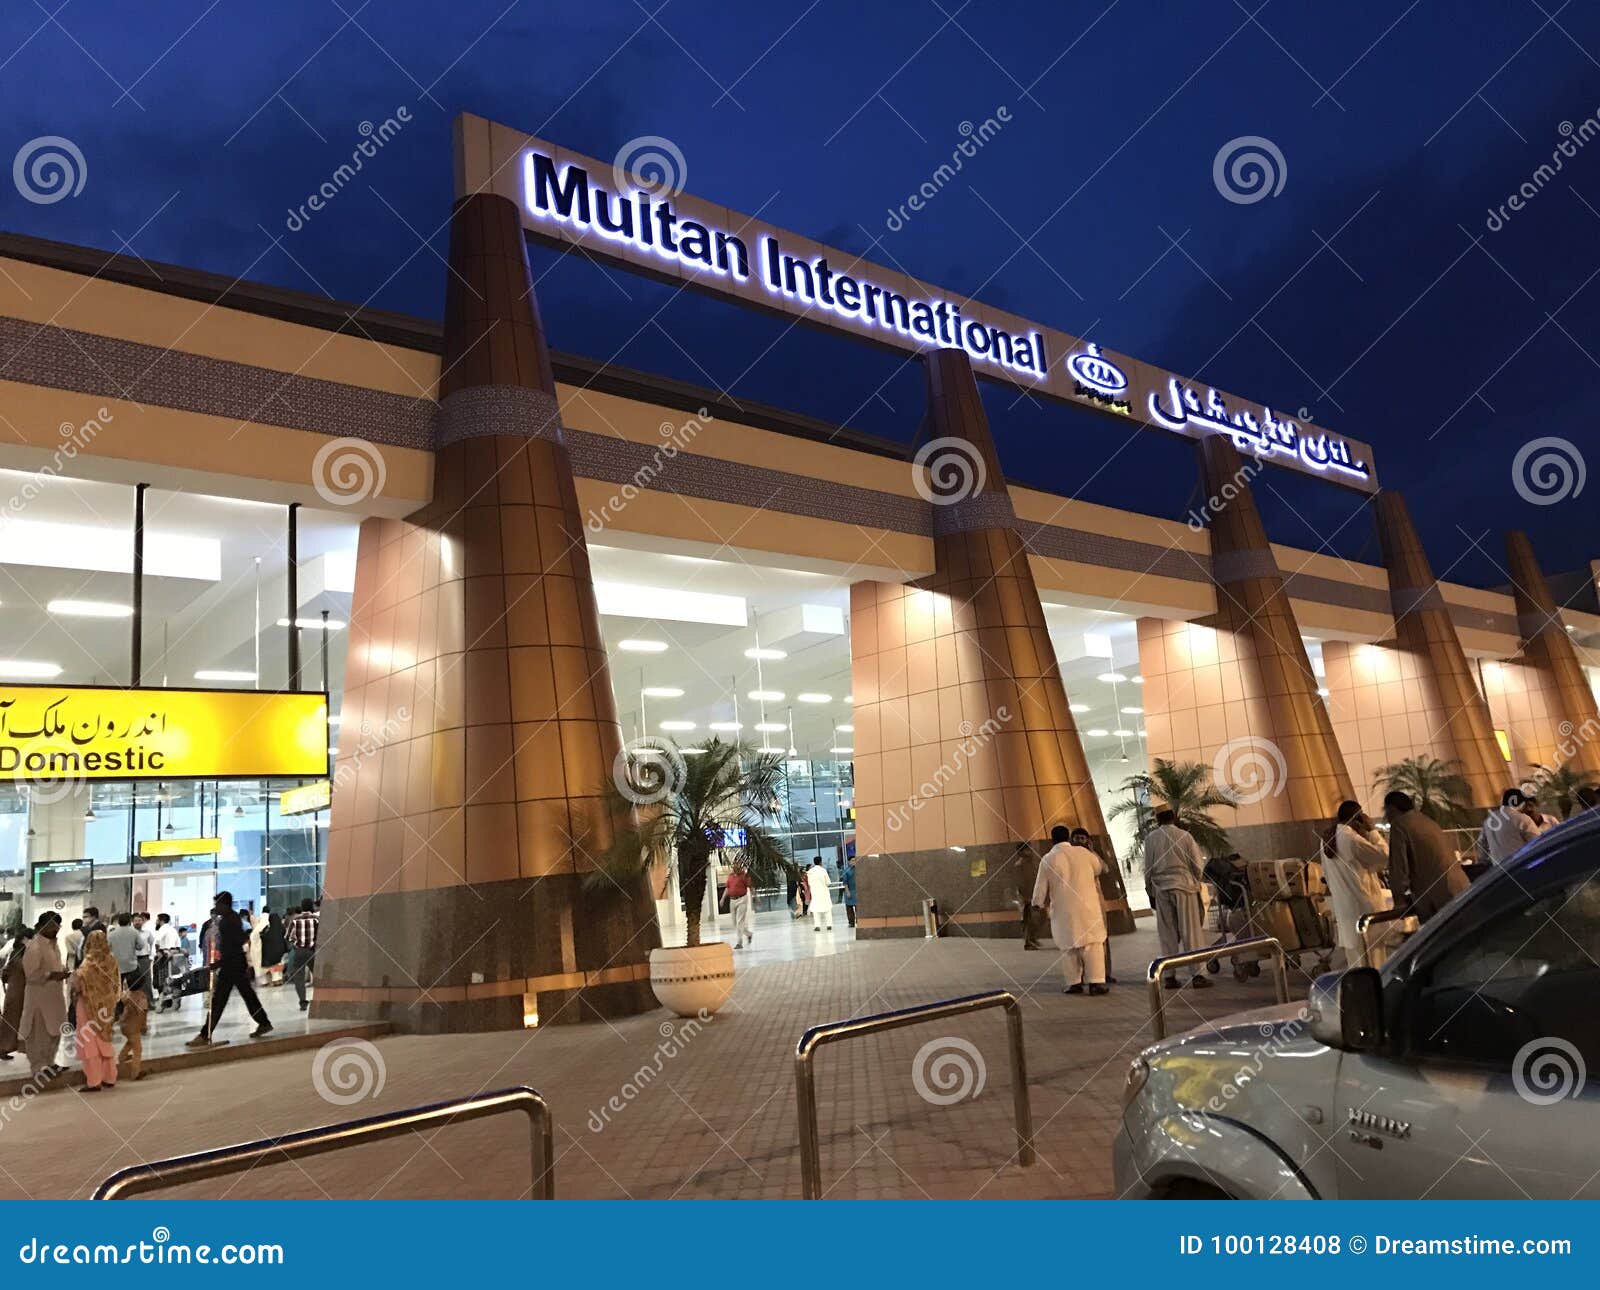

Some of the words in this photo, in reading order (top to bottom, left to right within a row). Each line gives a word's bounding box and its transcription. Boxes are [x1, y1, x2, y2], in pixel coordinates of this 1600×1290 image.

[526, 152, 749, 281] Multan
[761, 235, 1049, 378] International
[8, 695, 69, 738] ملک
[71, 712, 165, 745] اندرون
[0, 746, 165, 771] Domestic
